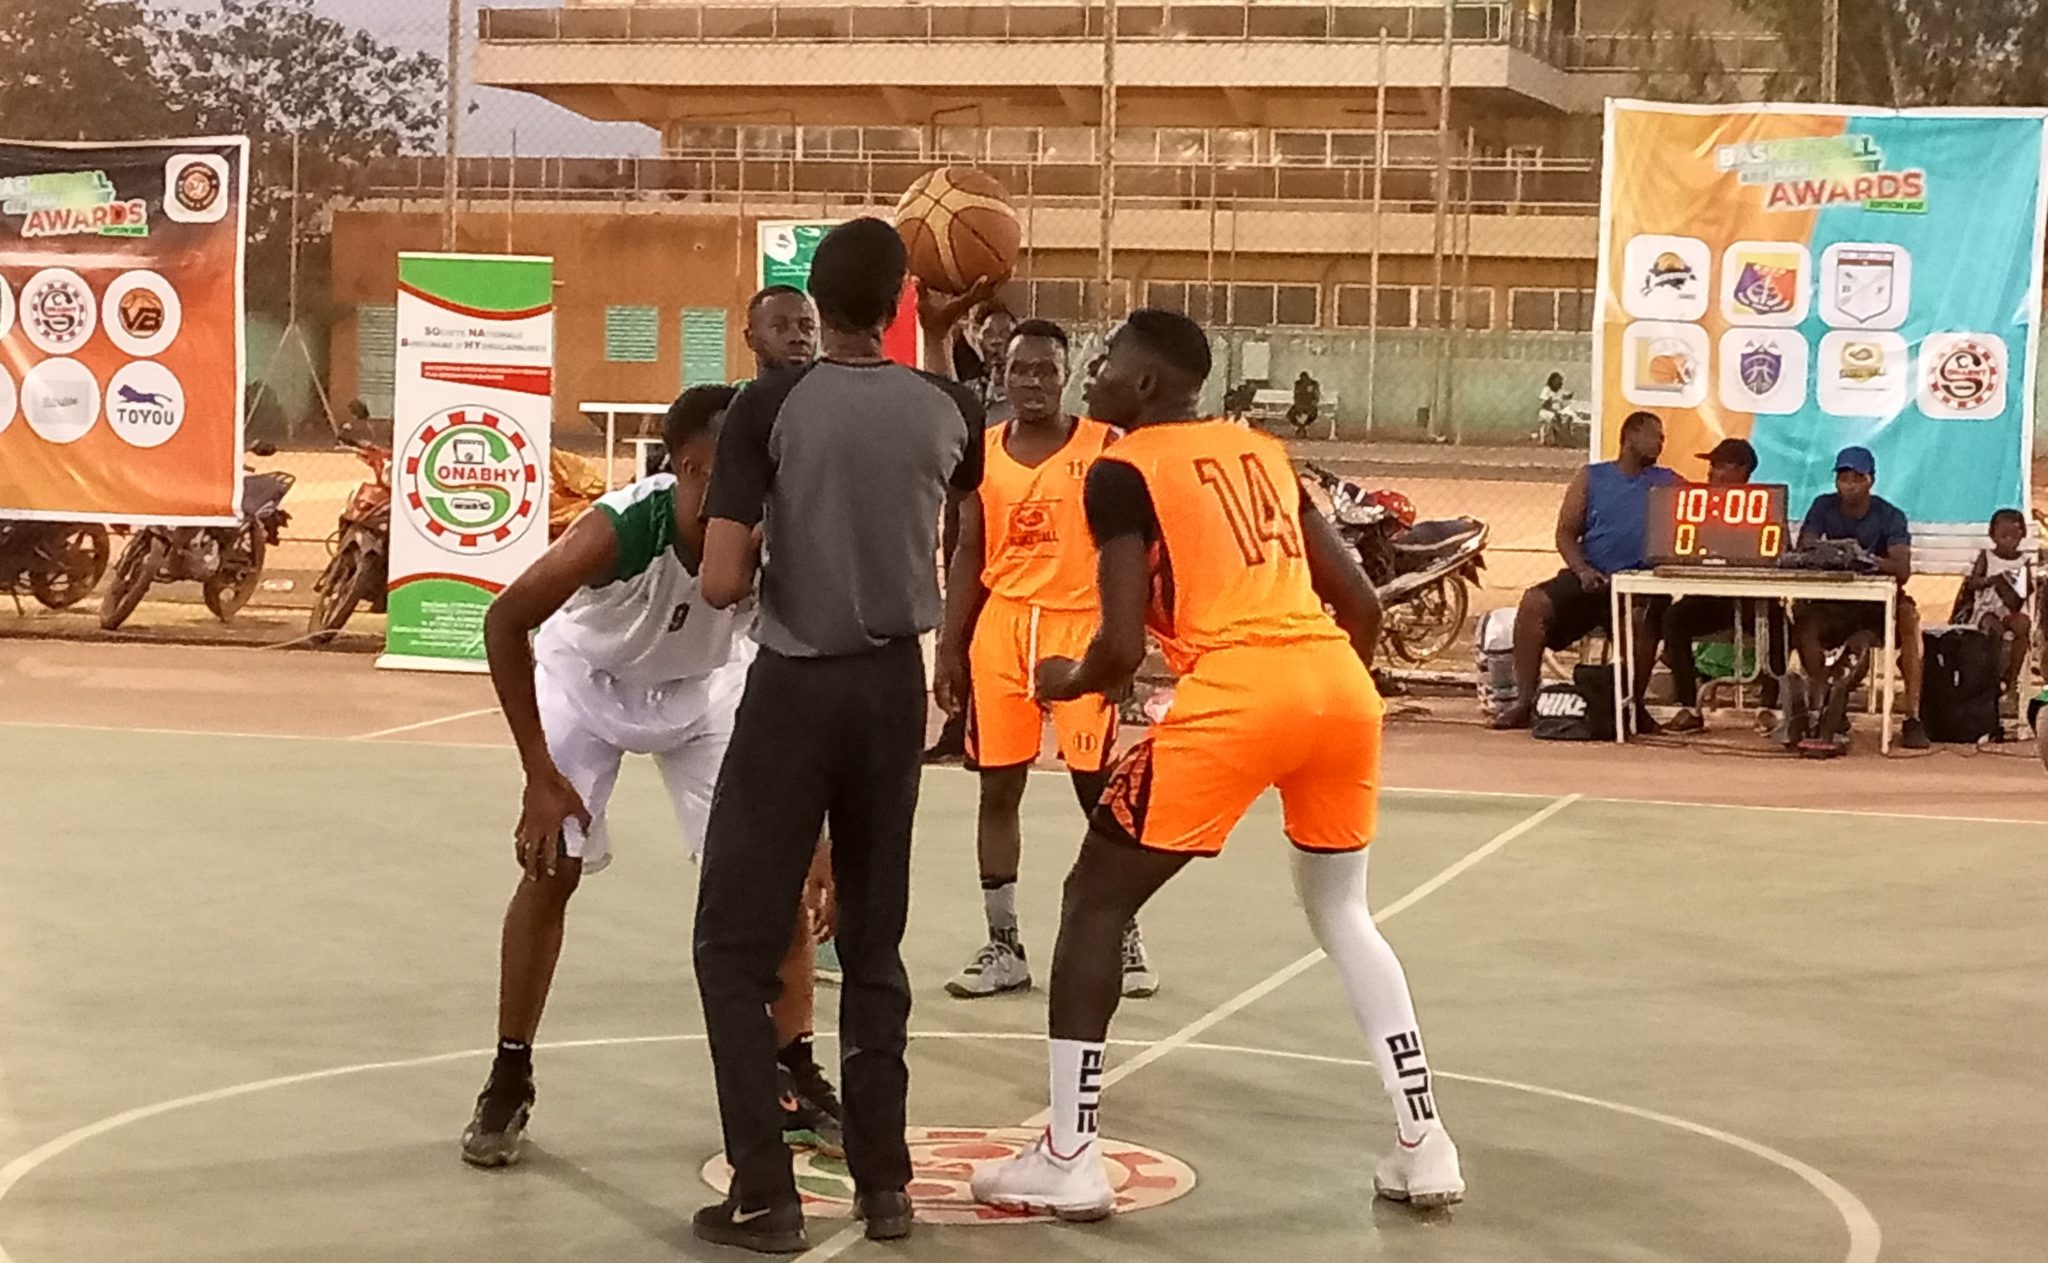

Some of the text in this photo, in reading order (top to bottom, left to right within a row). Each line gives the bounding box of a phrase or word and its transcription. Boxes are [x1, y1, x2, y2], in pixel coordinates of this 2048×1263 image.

[1767, 172, 1922, 208] AWARDS
[28, 203, 142, 232] AWARDS
[121, 307, 162, 331] VB
[117, 408, 174, 426] TOYOU
[438, 465, 520, 482] ONABHY
[1067, 460, 1084, 477] 11
[1193, 453, 1301, 567] 14
[1676, 488, 1769, 524] 10:00
[1760, 525, 1781, 557] 0
[1536, 692, 1587, 717] NIKE
[1385, 1031, 1434, 1121] ELITE
